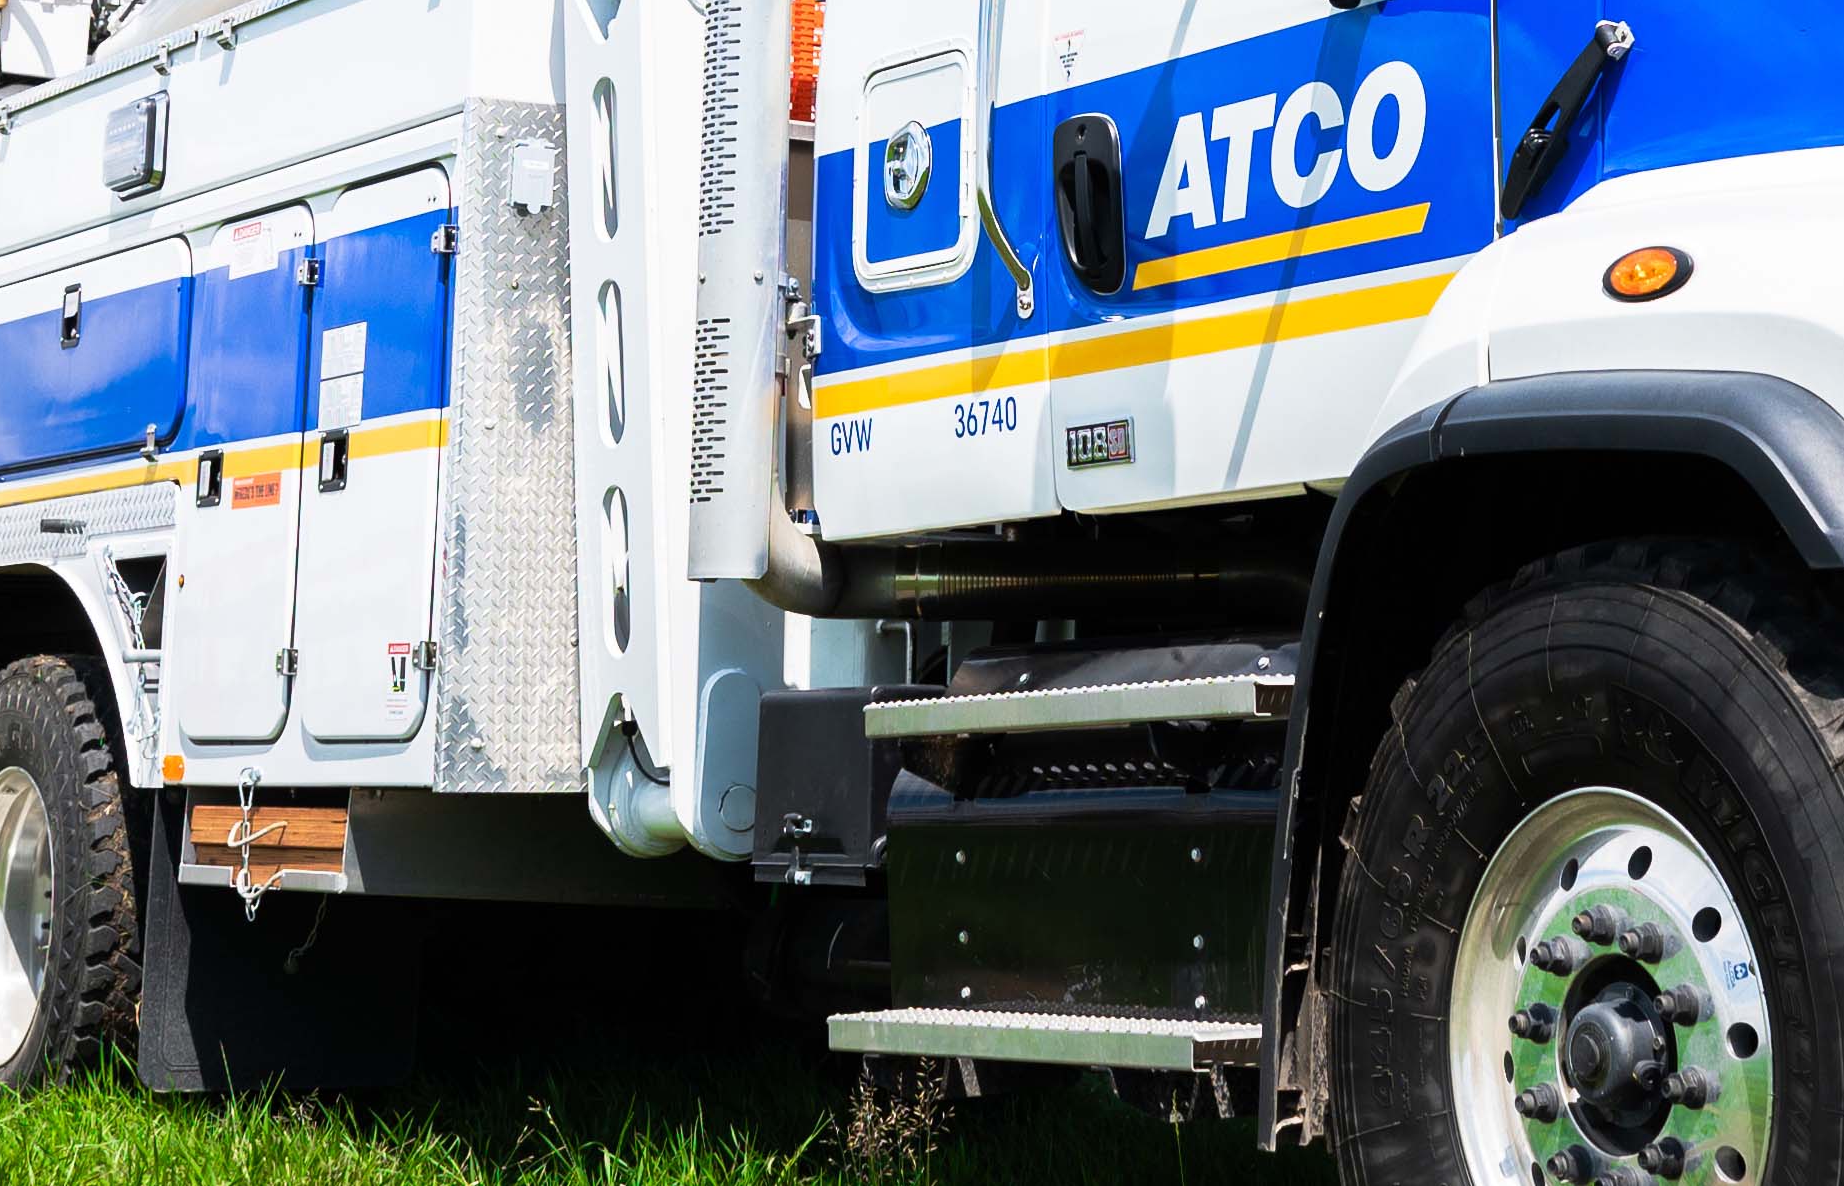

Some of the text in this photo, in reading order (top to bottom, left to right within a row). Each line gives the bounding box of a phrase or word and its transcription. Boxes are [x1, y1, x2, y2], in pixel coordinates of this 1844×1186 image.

[1145, 61, 1426, 238] ATCO
[831, 418, 872, 455] GVW
[954, 396, 1017, 438] 36740
